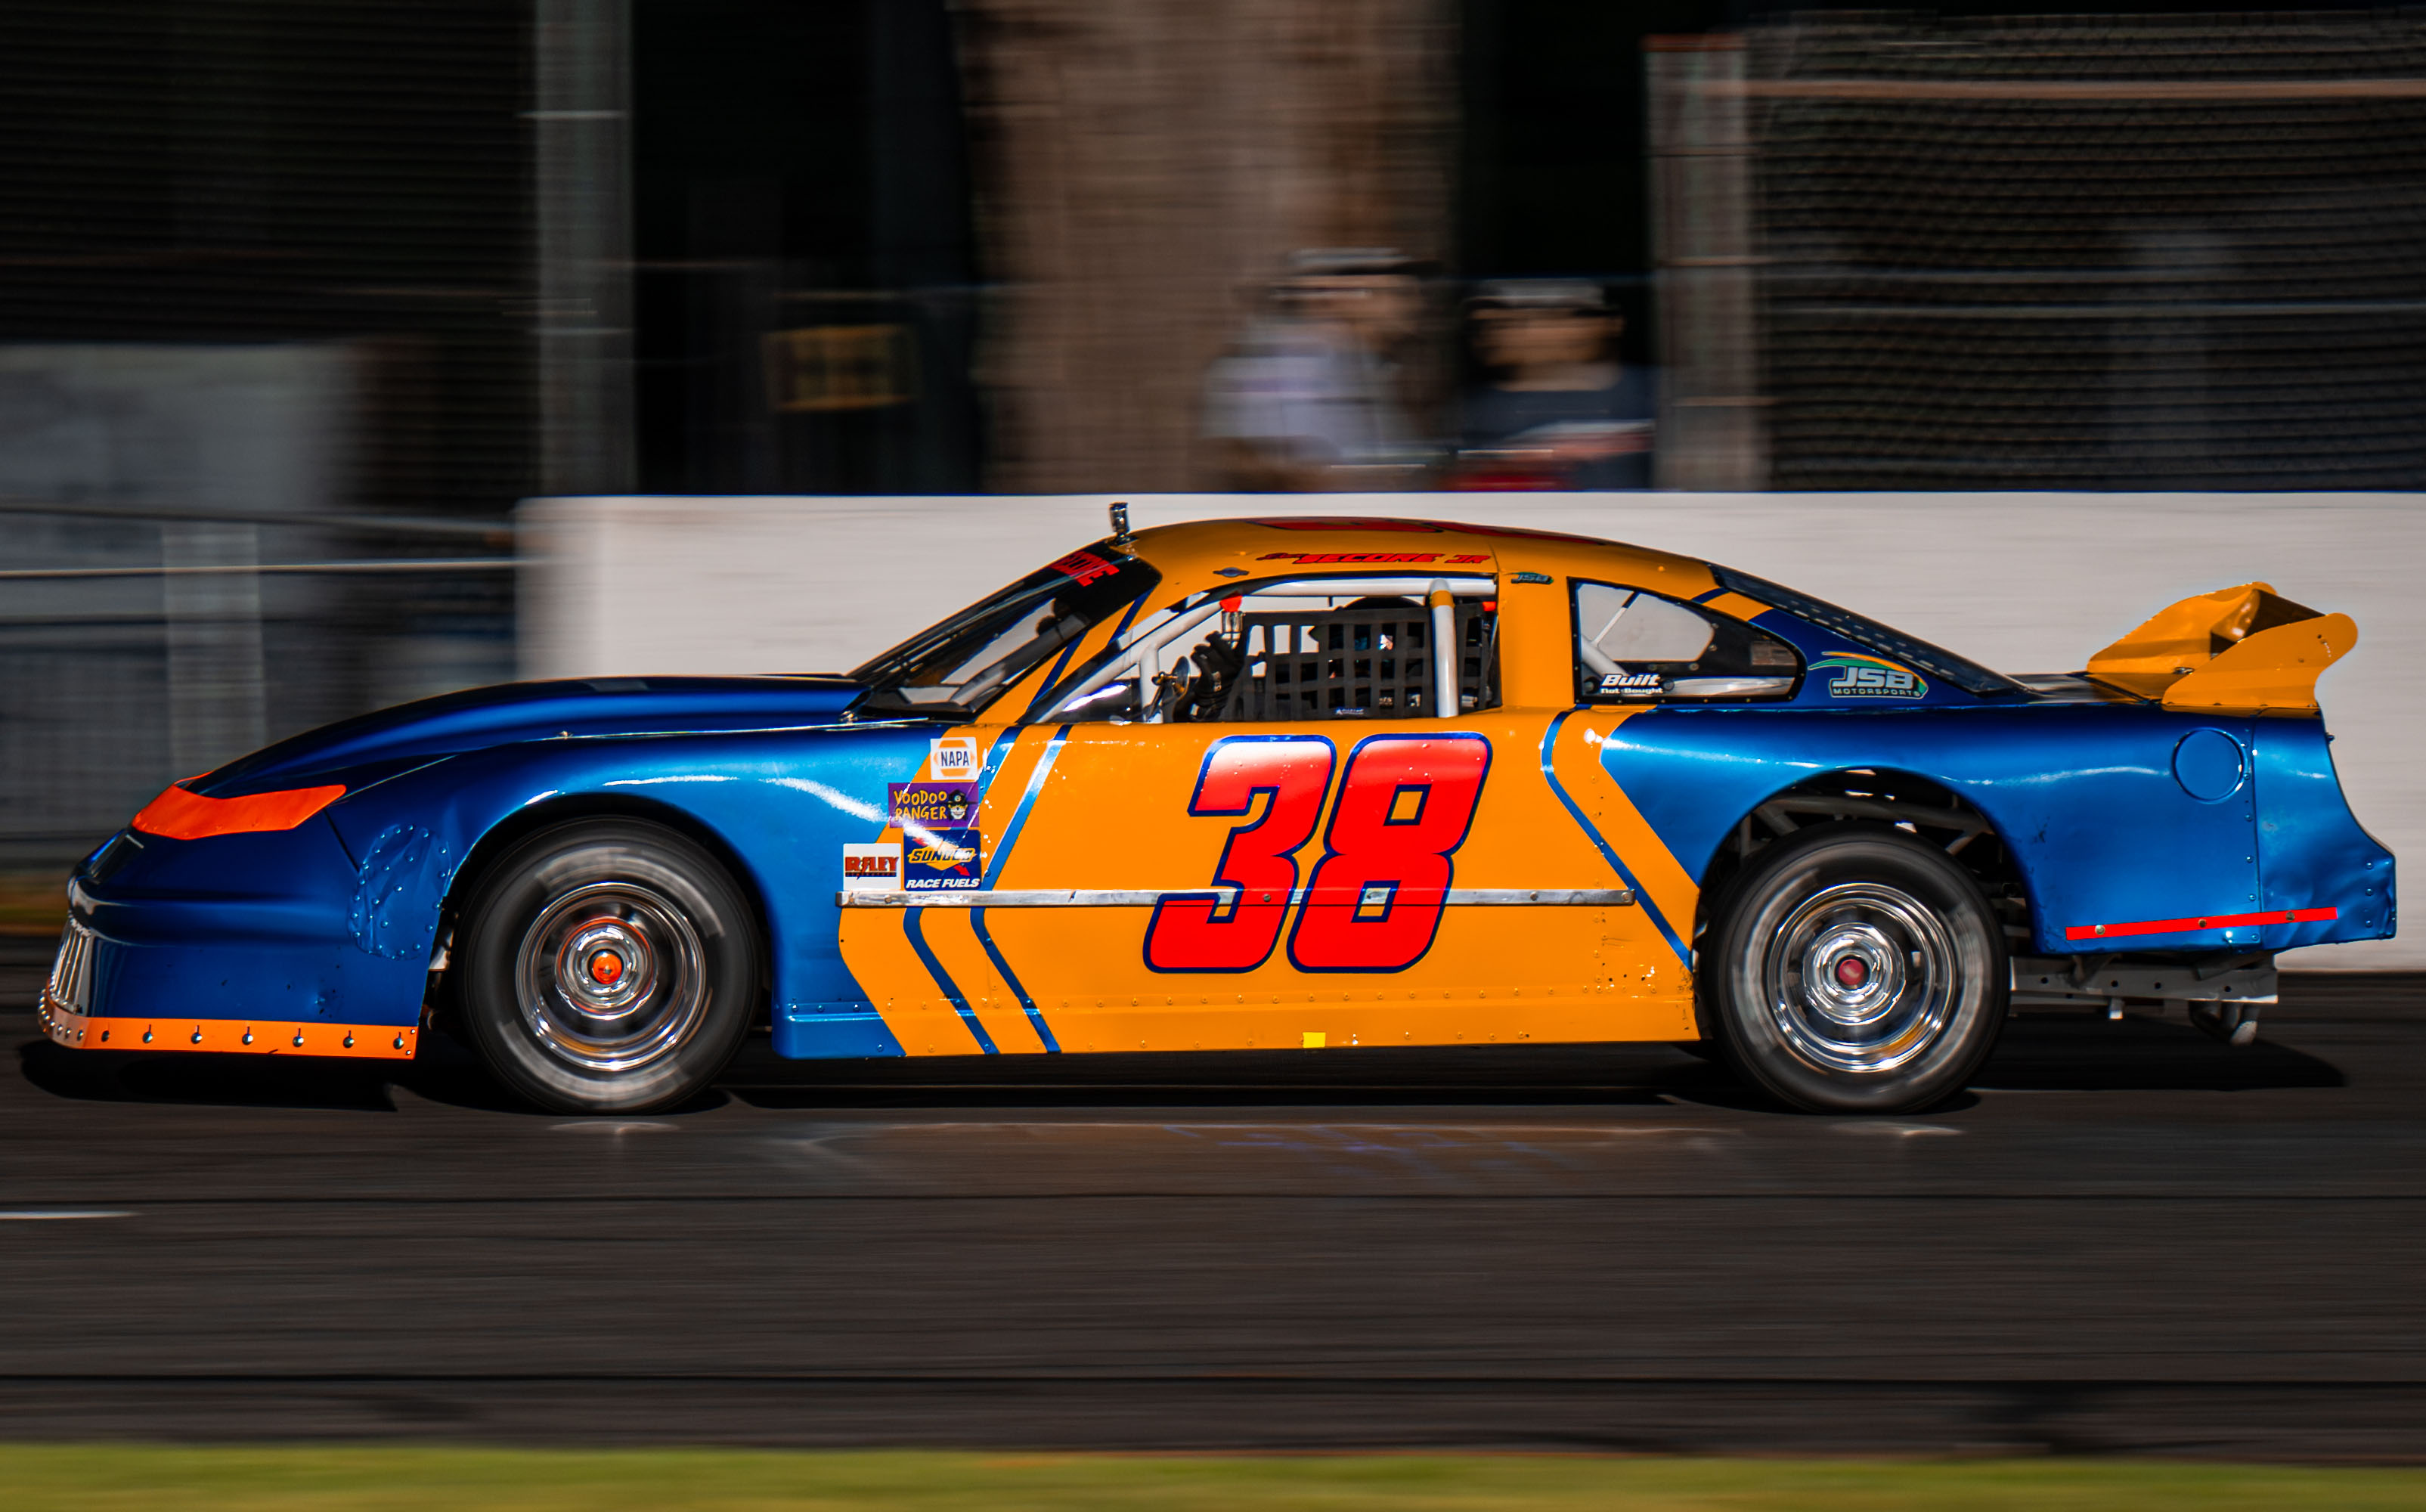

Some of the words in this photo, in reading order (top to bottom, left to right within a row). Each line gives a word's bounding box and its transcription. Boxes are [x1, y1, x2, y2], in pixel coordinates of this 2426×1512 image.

[1601, 674, 1661, 686] Built
[1832, 667, 1913, 689] JSB
[1833, 688, 1921, 697] MOTORSPORTS
[940, 751, 969, 767] NAPA
[894, 790, 947, 806] VOODOO
[895, 805, 947, 821] RANGER
[1142, 732, 1493, 974] 38
[906, 878, 942, 888] RACE
[941, 878, 981, 888] FUELS
